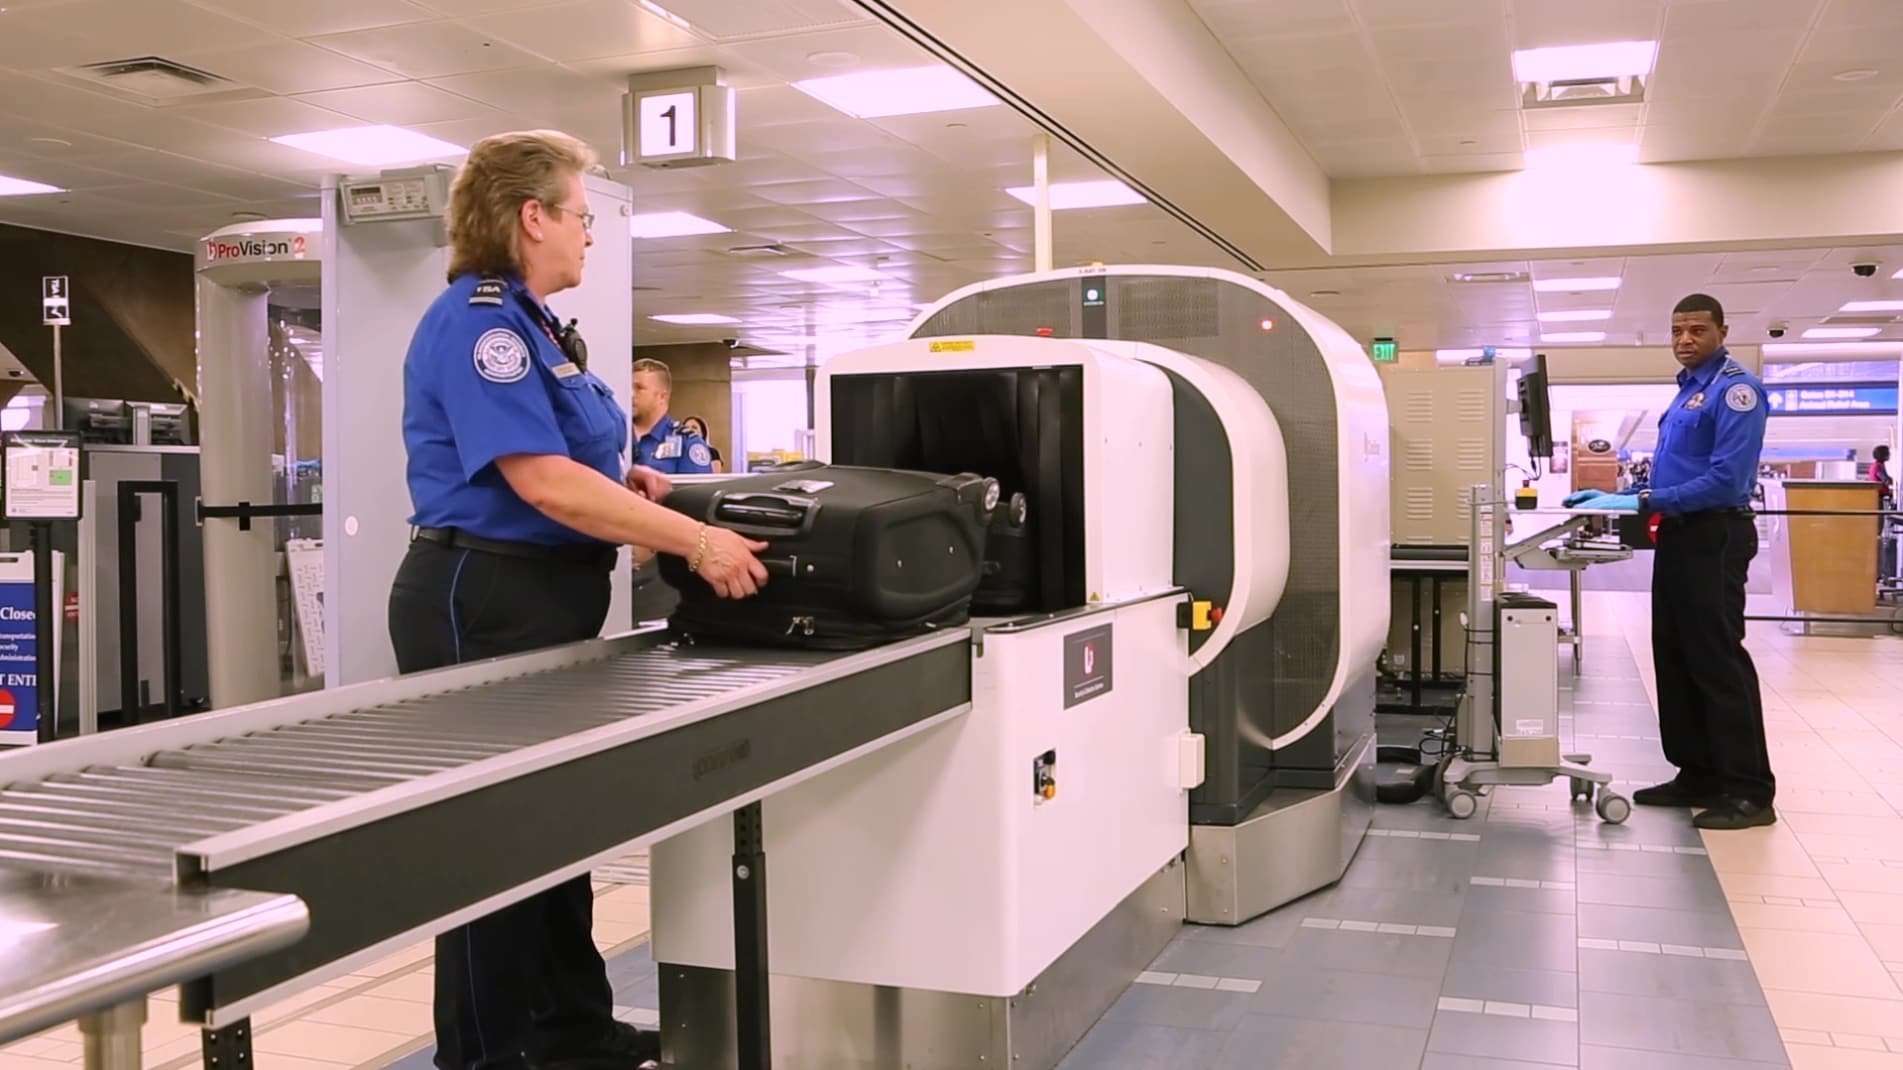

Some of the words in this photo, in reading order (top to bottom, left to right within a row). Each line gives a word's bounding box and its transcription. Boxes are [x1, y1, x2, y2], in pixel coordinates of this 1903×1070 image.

[659, 104, 677, 147] 1
[218, 239, 289, 258] ProVision
[1373, 343, 1396, 361] EXIT
